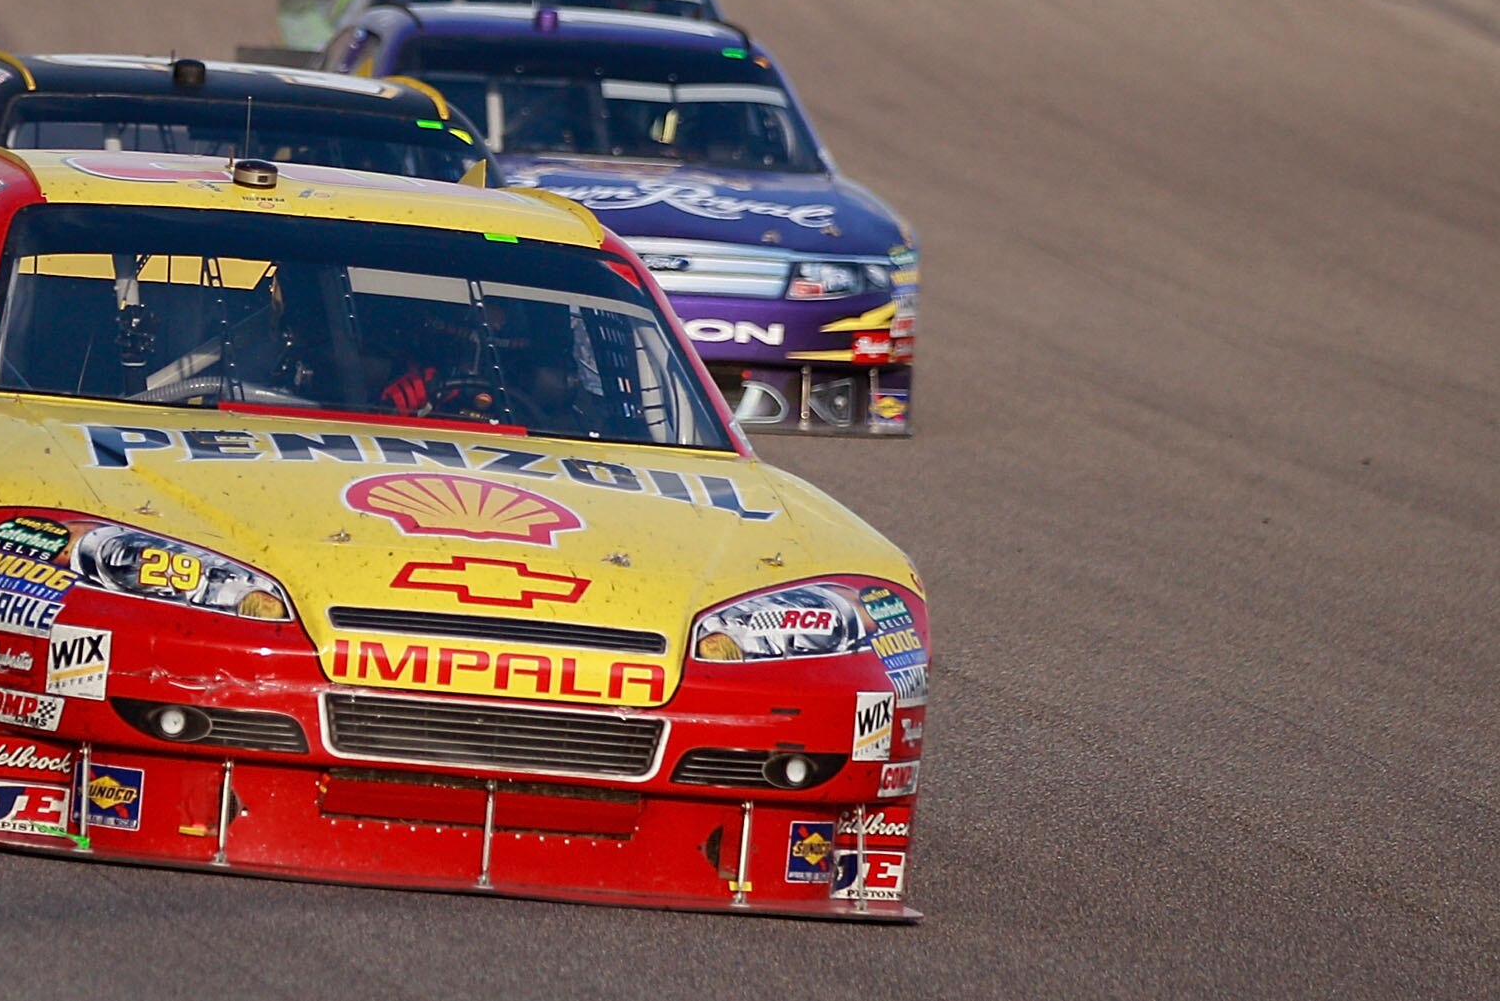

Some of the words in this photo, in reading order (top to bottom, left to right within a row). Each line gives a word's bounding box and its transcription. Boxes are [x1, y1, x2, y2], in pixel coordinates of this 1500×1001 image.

[80, 423, 781, 522] PENNZOIL
[139, 549, 201, 592] 29
[782, 609, 833, 631] RCR
[51, 634, 106, 670] WIX
[871, 628, 922, 659] MOOG
[332, 638, 668, 703] IMPALA
[857, 696, 893, 737] WIX
[81, 784, 135, 802] UNOCO
